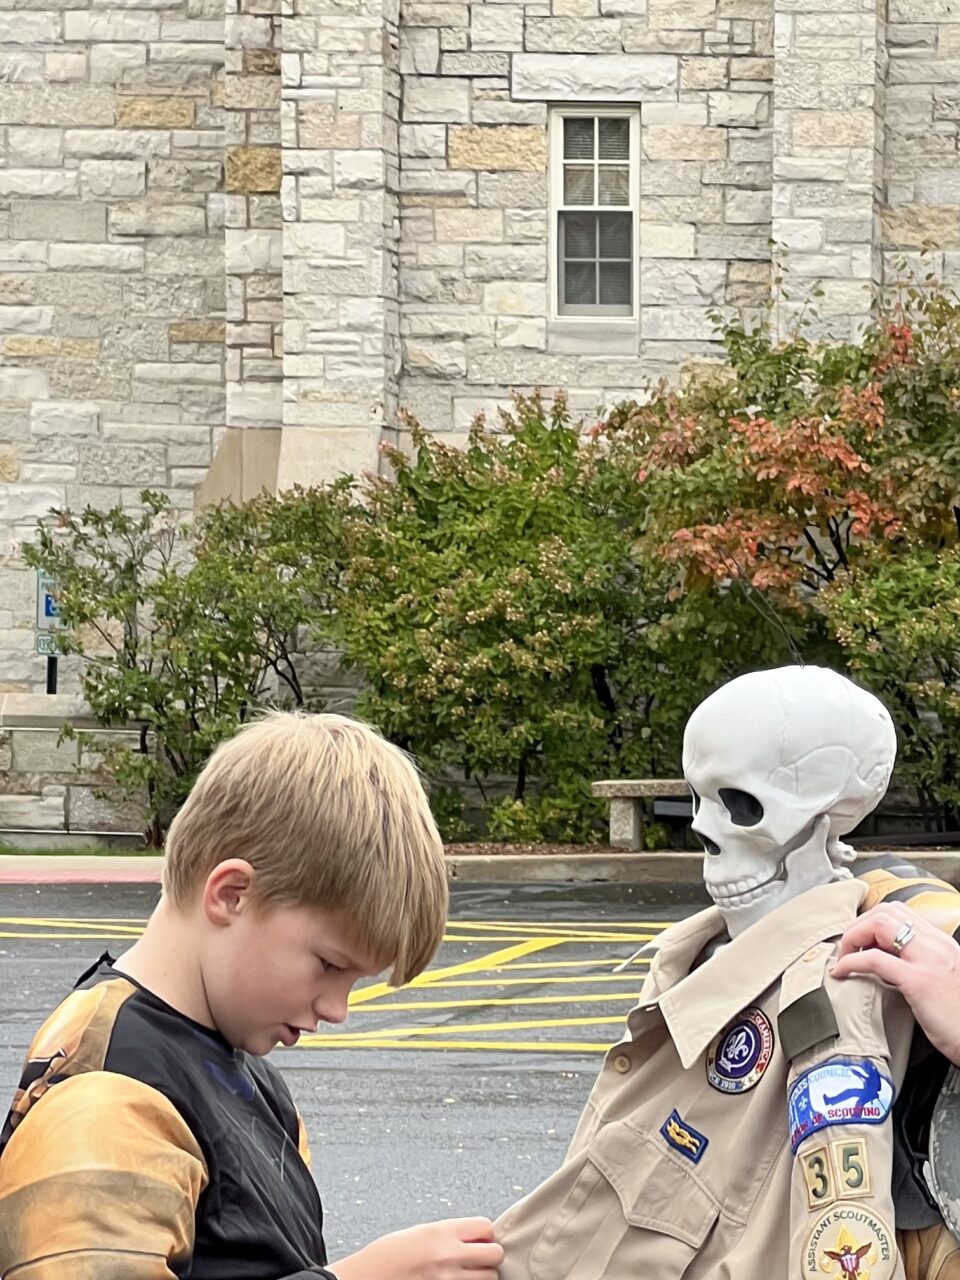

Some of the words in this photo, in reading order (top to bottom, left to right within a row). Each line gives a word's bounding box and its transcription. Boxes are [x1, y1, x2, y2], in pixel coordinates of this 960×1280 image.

[720, 1080, 736, 1090] 1910
[827, 1106, 880, 1119] SCOUTING
[808, 1216, 832, 1272] ASSISTANT
[833, 1210, 890, 1261] SCOUTMASTER
